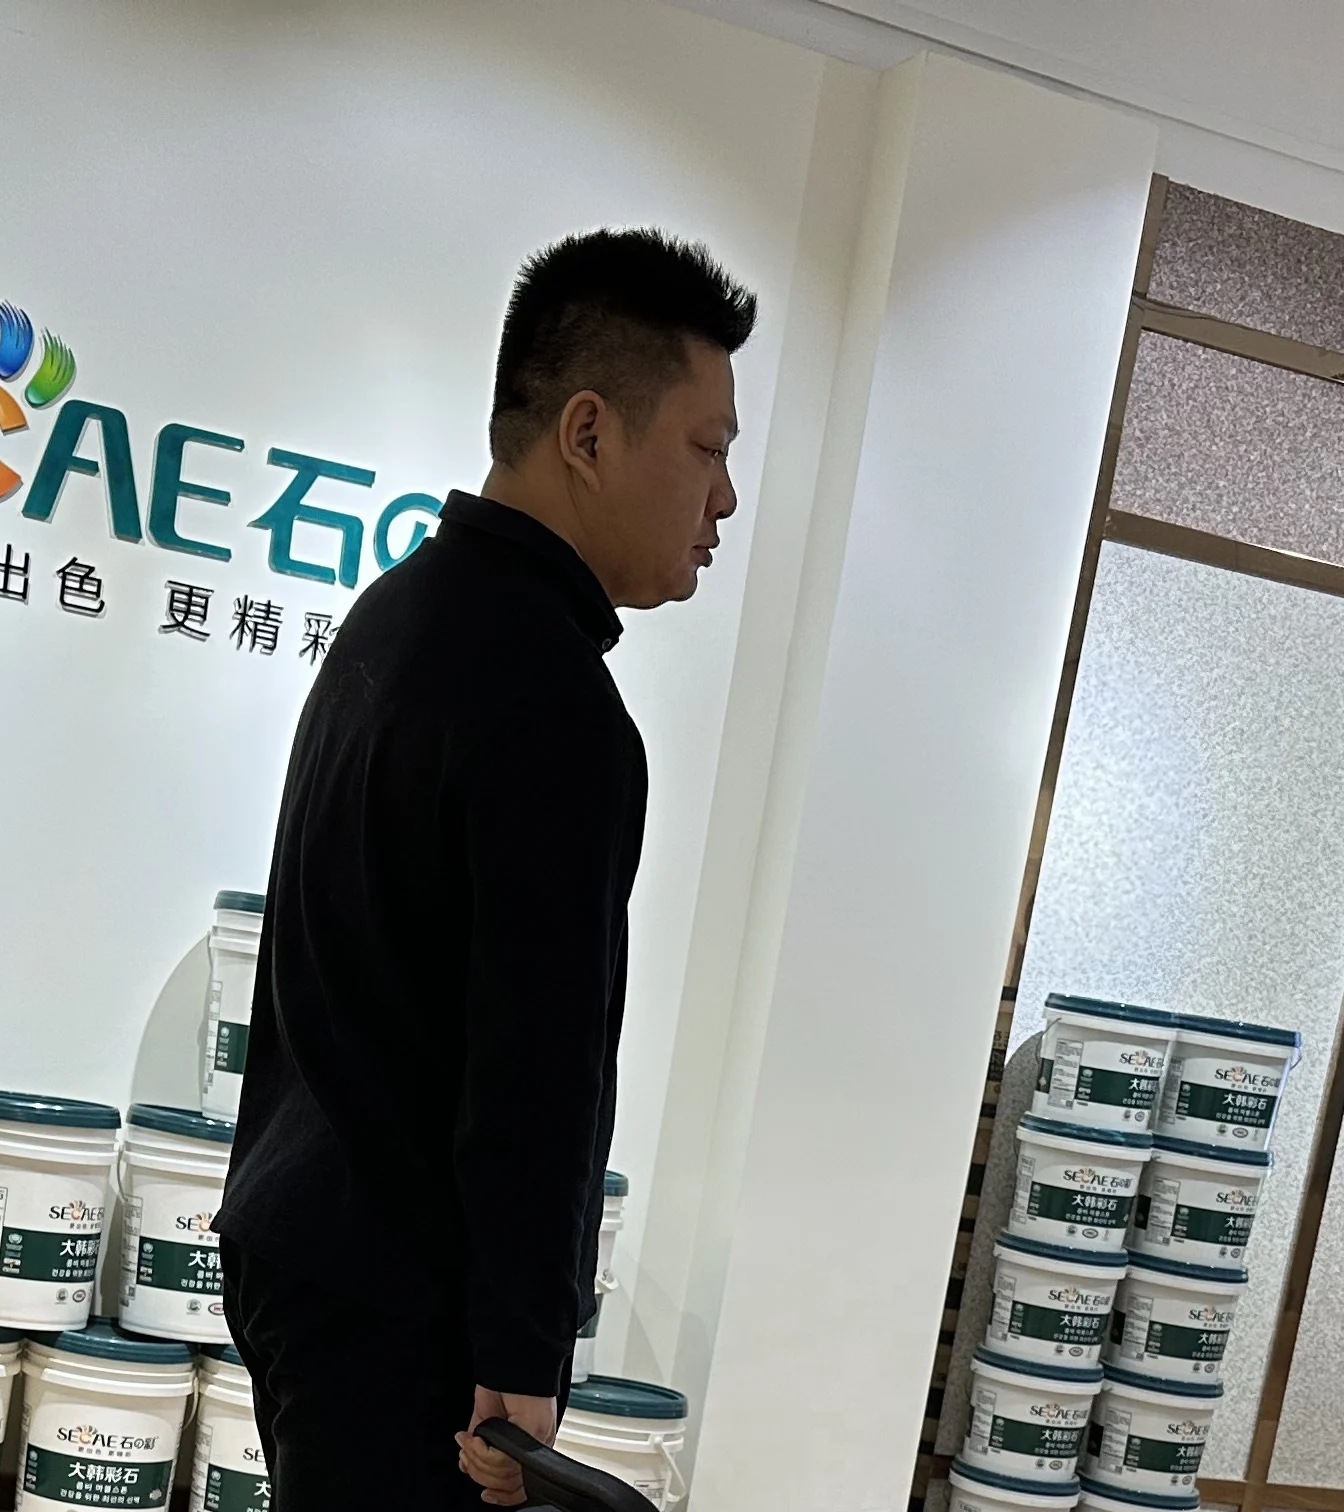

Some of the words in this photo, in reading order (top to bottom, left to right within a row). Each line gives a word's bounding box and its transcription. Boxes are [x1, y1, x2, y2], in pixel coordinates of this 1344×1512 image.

[57, 1426, 155, 1450] SECAE石の彩
[68, 1461, 140, 1484] 大韩彩石
[254, 1481, 271, 1497] 大
